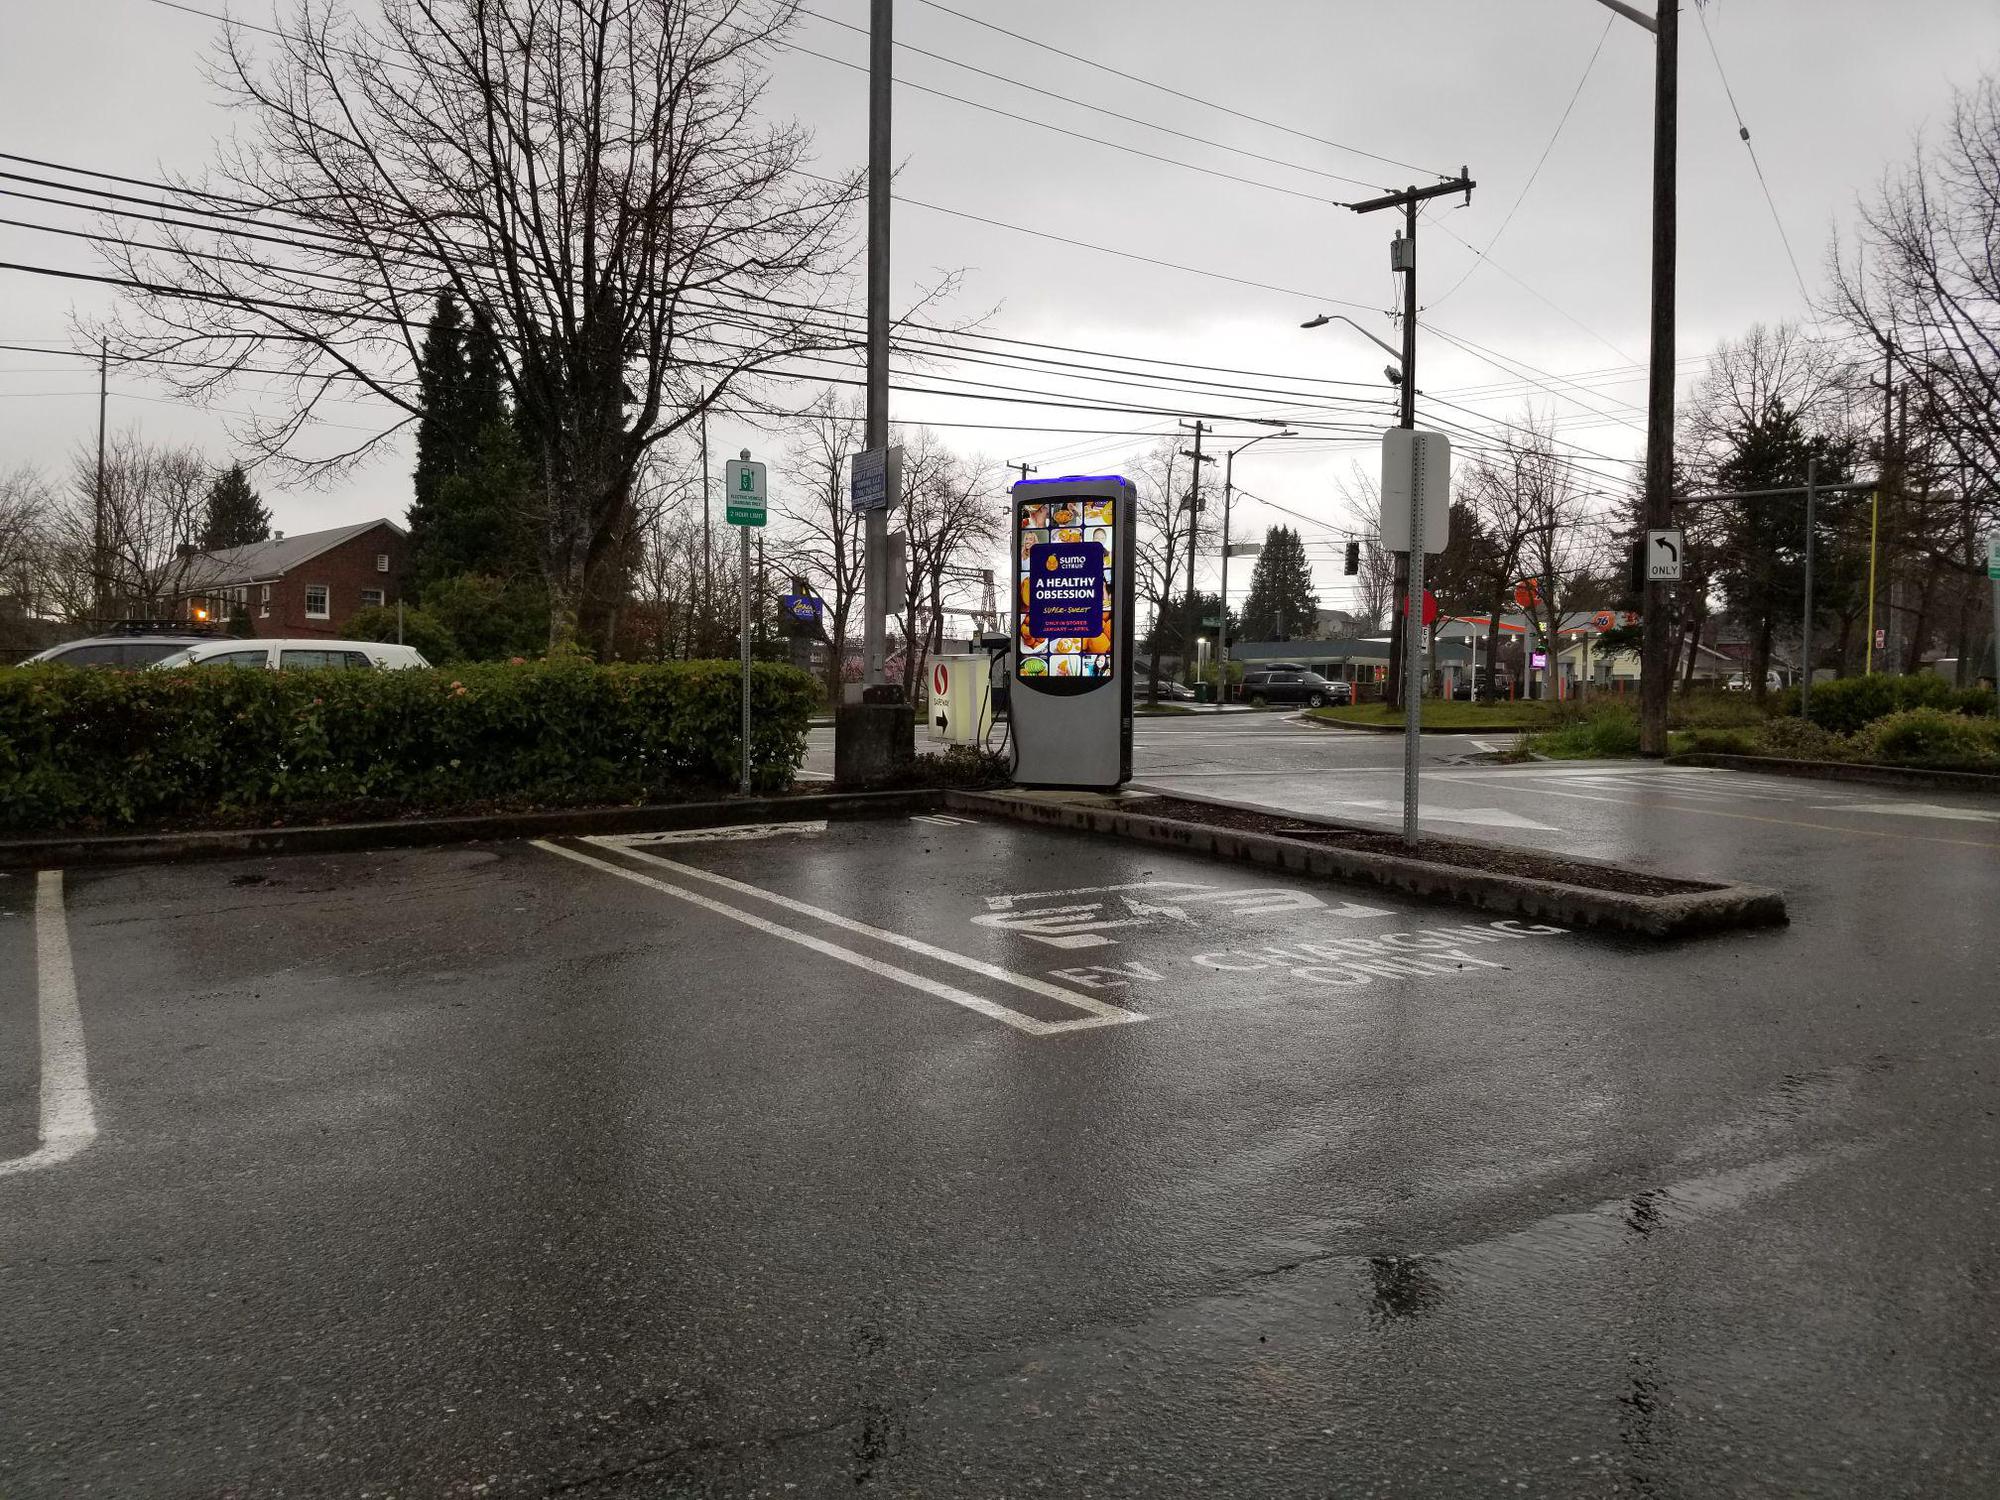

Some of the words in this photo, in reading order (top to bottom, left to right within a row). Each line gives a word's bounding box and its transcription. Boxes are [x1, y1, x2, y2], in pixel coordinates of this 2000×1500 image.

[1652, 565, 1678, 575] ONLY
[1036, 578, 1044, 588] A
[1046, 577, 1095, 588] HEALTHY
[1036, 589, 1095, 599] OBSESSION
[1597, 616, 1609, 625] 76
[1047, 962, 1166, 988] EV
[1191, 920, 1572, 971] CHARGING
[1290, 950, 1503, 984] ONLY
